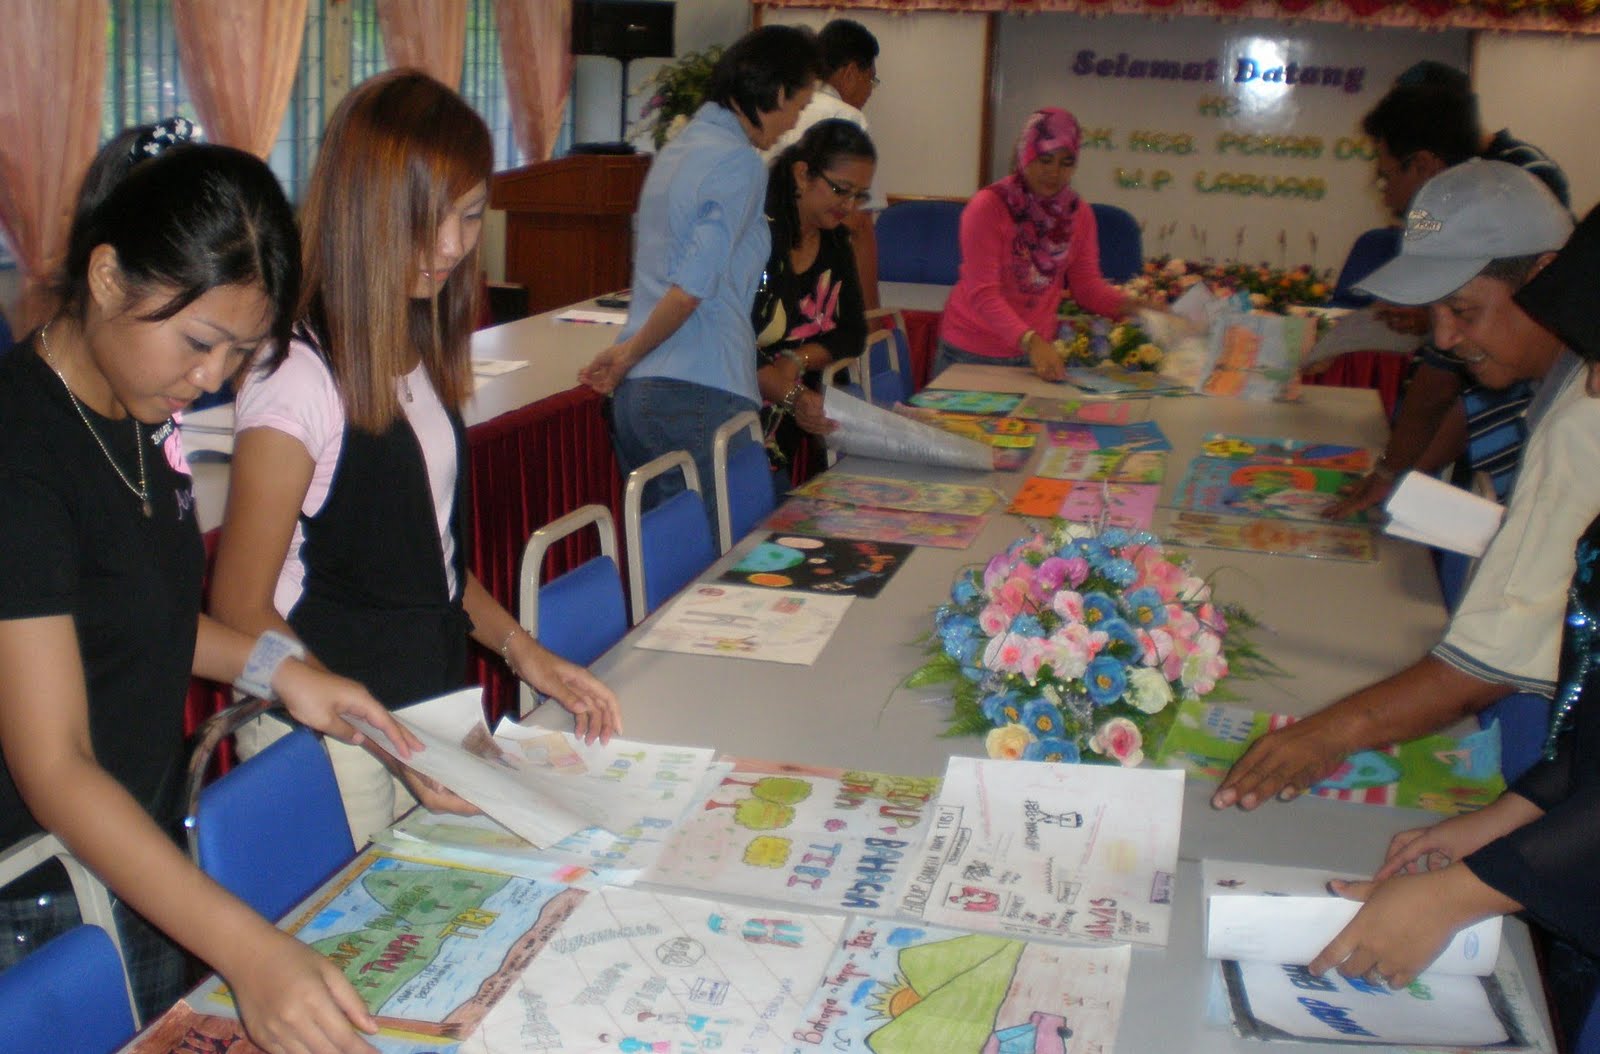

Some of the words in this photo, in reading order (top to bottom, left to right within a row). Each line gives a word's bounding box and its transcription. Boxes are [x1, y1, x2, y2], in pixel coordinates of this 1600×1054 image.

[1072, 50, 1219, 81] Selamat
[1234, 57, 1366, 94] Datang
[1194, 170, 1327, 200] LABUAN
